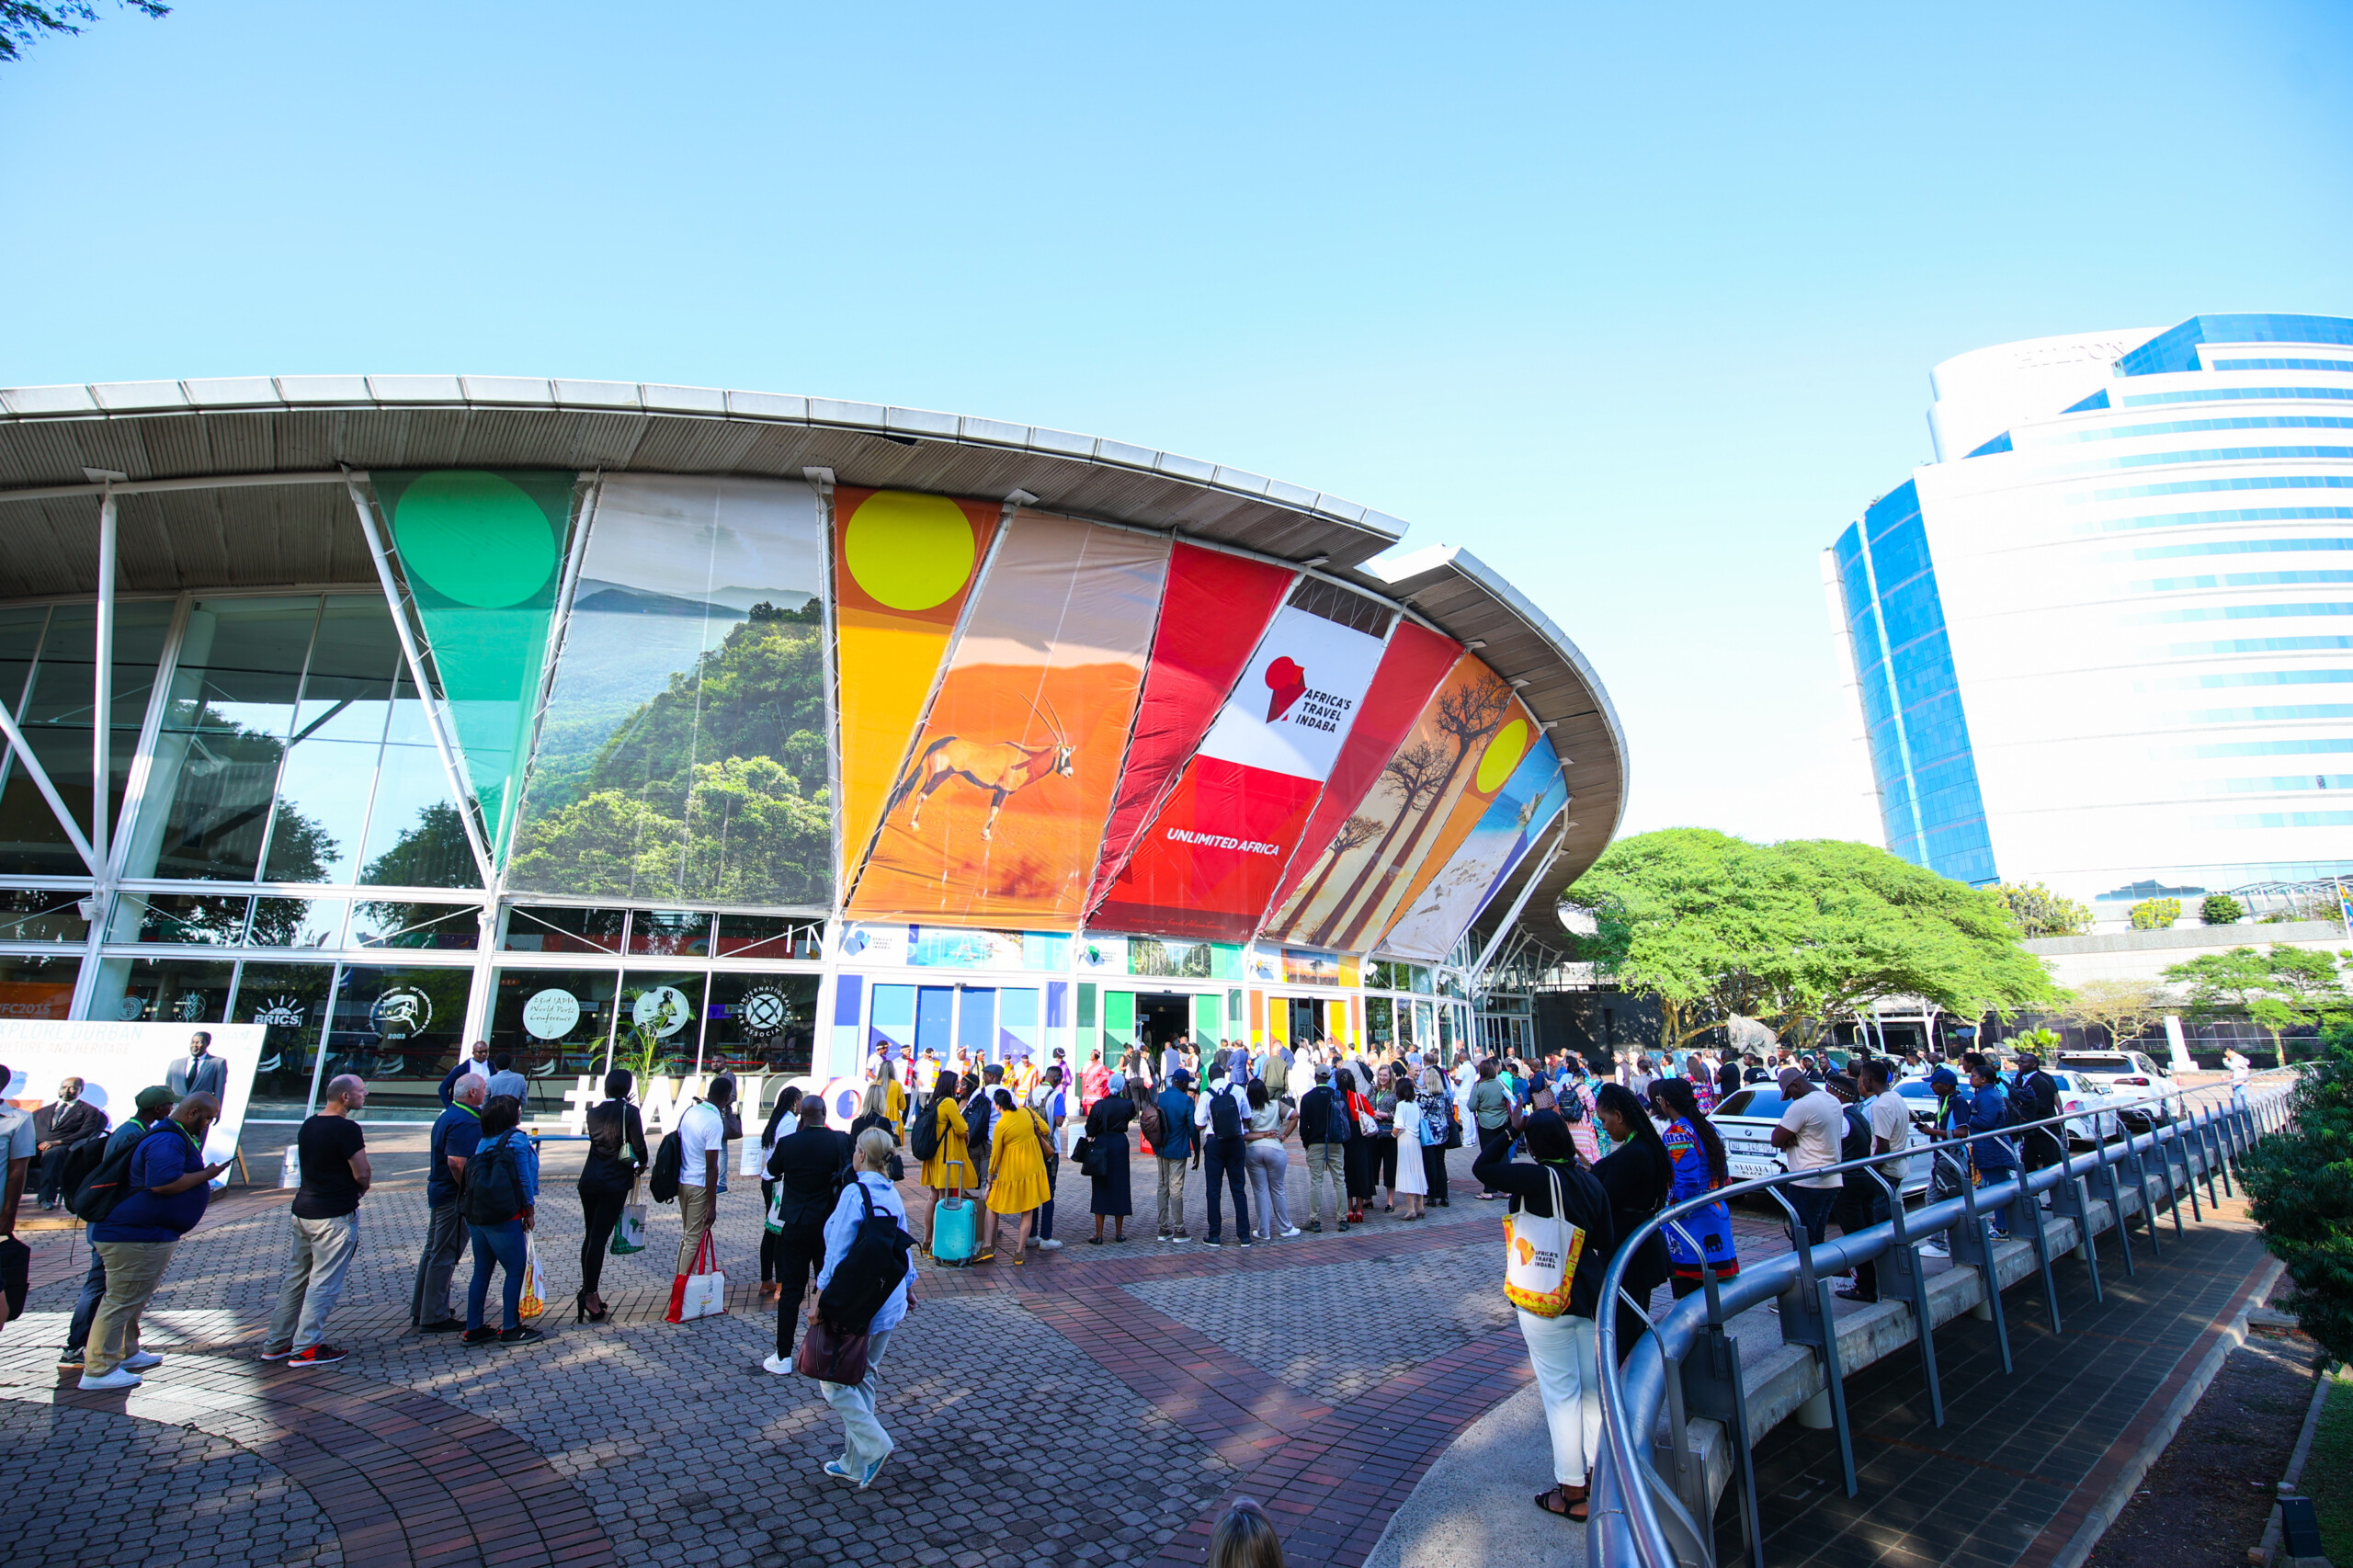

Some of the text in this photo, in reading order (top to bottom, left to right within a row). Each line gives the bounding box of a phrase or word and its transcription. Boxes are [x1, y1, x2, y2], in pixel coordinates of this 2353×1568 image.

[1304, 688, 1352, 710] AFRICA'S
[1302, 701, 1342, 722] TRAVEL
[1295, 713, 1336, 733] INDABA
[1166, 827, 1280, 856] UNLIMITED AFRICA
[533, 996, 551, 1006] 23rd
[739, 985, 791, 1008] INTERNATIONAL
[529, 1005, 575, 1014] World Ports
[254, 1014, 301, 1026] BRICS
[529, 1013, 572, 1024] Conference
[744, 1011, 791, 1038] ASSOCIATION
[71, 1023, 144, 1041] DURBAN
[74, 1041, 132, 1056] HERITAGE
[1733, 1164, 1768, 1173] SYAVAYA
[1535, 1250, 1559, 1258] AFRICA'S
[1535, 1256, 1556, 1264] TRAVEL
